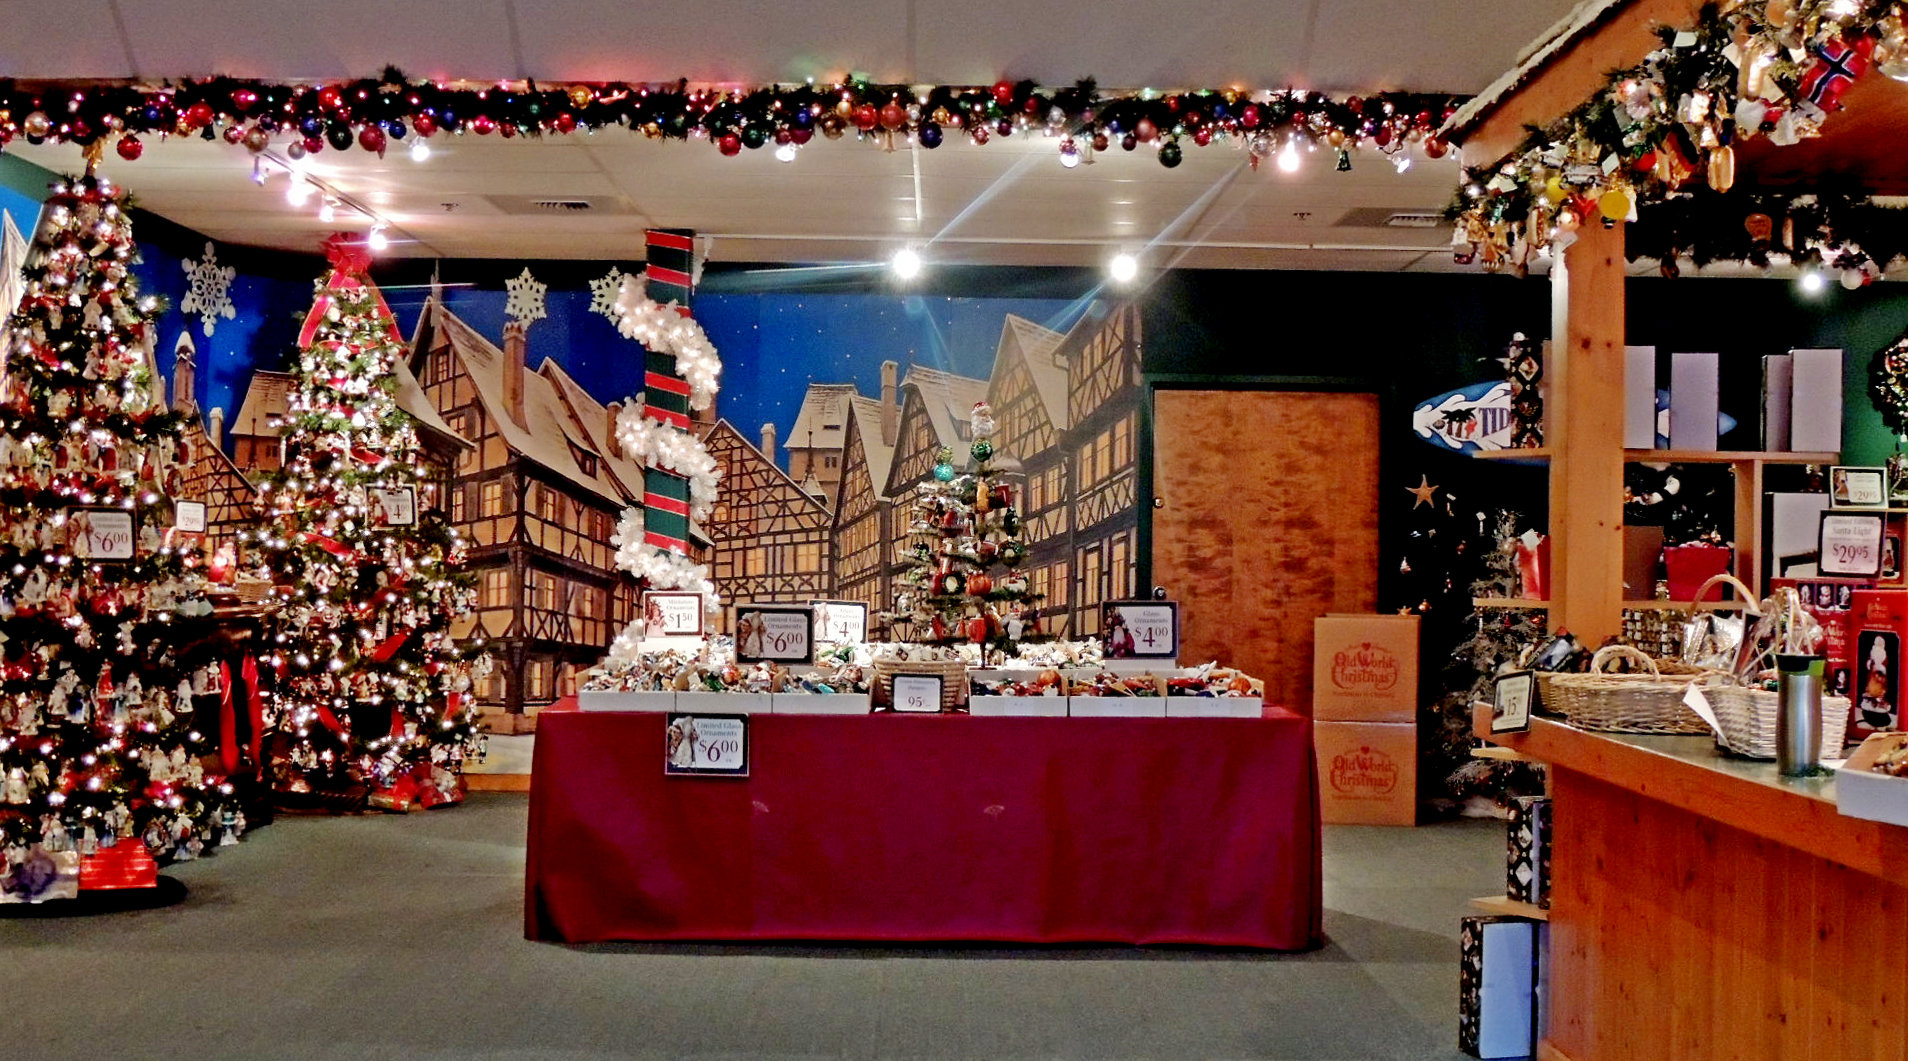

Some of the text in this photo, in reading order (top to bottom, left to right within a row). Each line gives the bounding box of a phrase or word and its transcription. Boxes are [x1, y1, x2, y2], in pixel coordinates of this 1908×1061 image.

[1333, 650, 1394, 669] Old World
[1331, 664, 1398, 691] Christmas
[700, 729, 738, 737] Ornaments
[1330, 754, 1395, 773] Old World
[1329, 768, 1398, 795] Christmas
